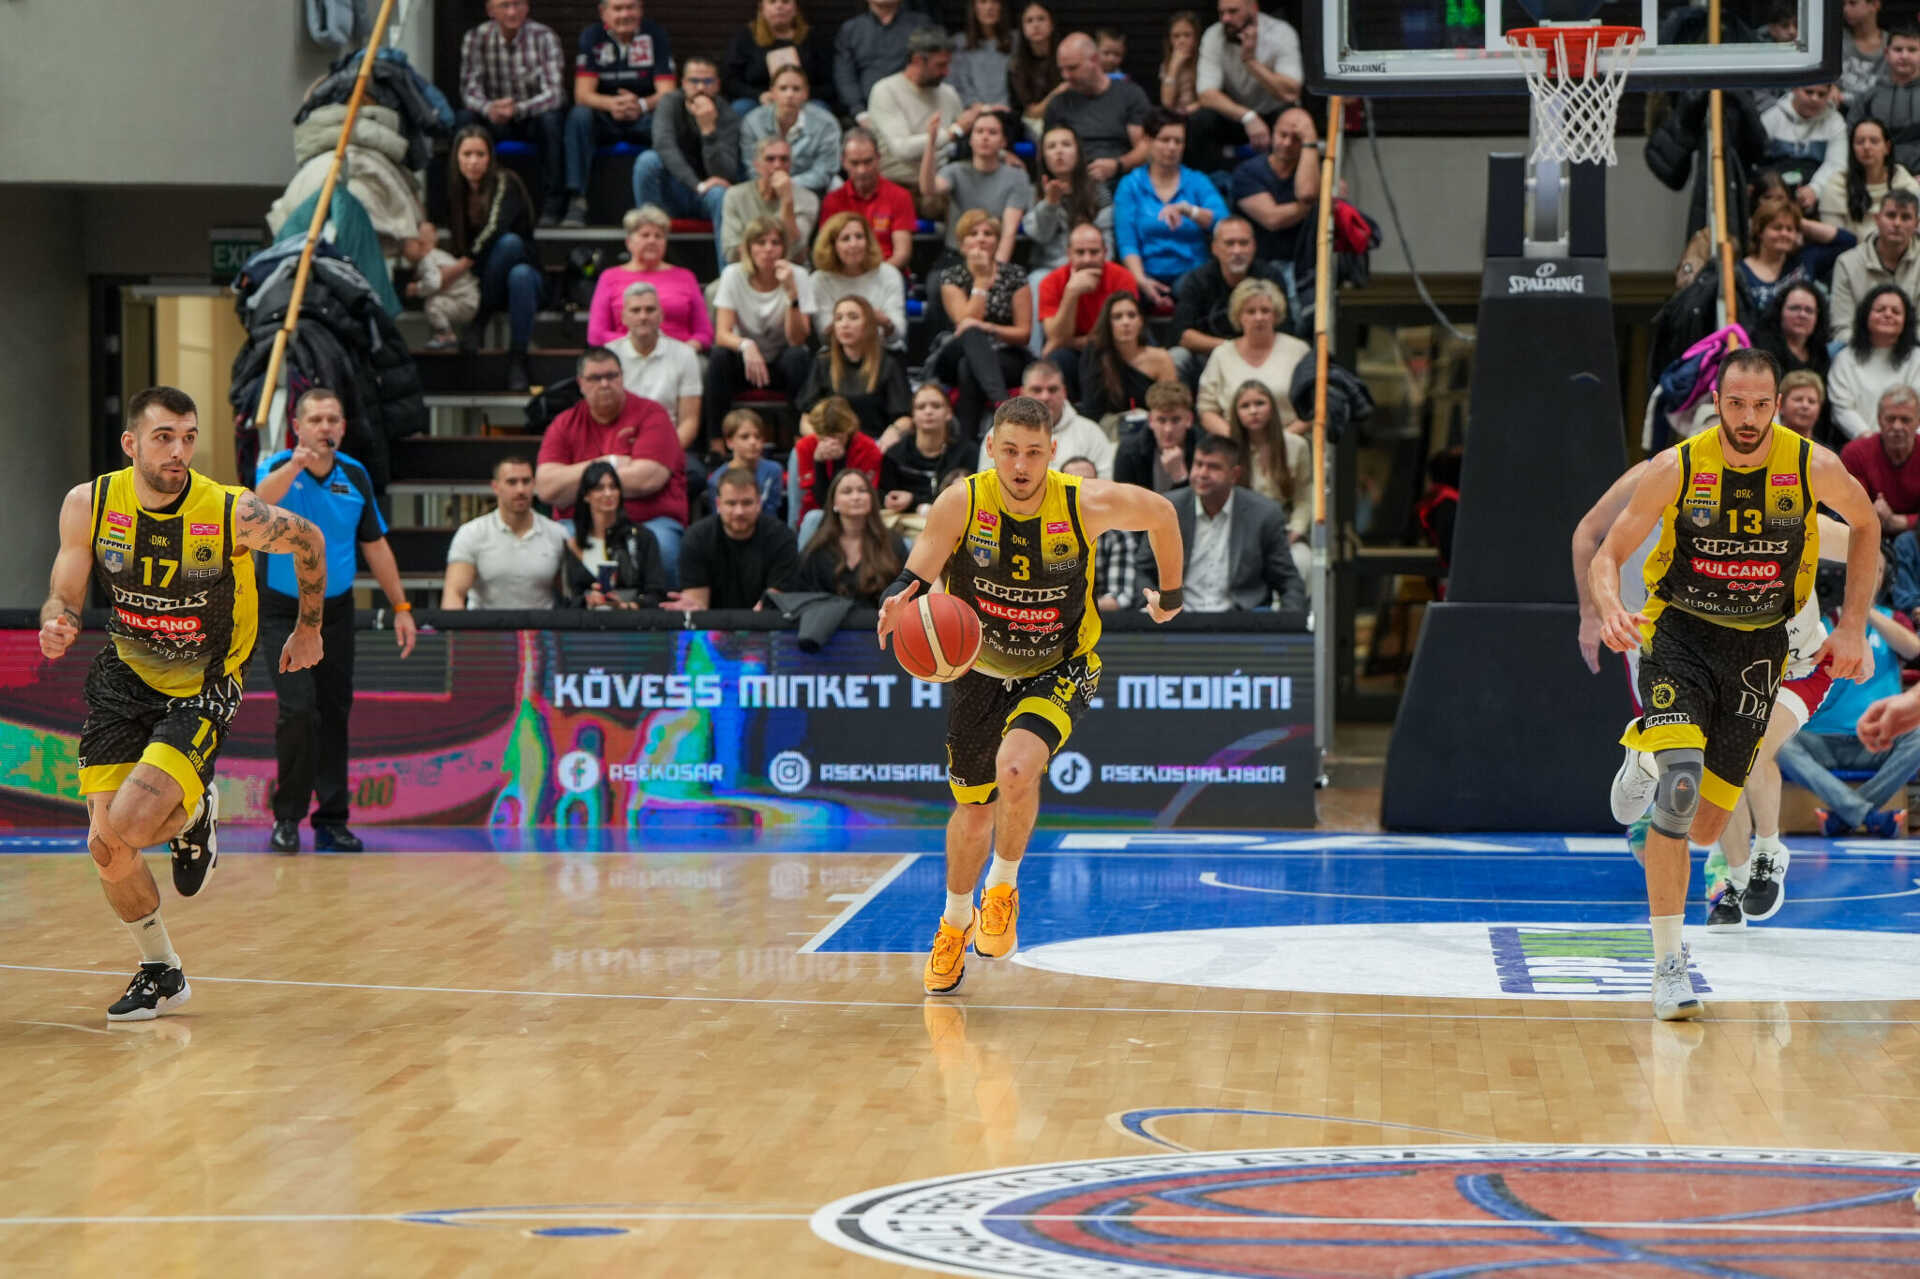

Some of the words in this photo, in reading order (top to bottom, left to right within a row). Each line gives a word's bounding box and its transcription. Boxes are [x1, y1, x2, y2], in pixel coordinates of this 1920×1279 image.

[1337, 62, 1387, 74] SPALDING
[1508, 274, 1584, 294] SPALDING
[1726, 508, 1764, 535] 13
[140, 556, 179, 588] 17
[1011, 554, 1031, 581] 3
[1693, 560, 1778, 578] VULCANO
[979, 601, 1056, 621] VULCANO
[554, 667, 723, 709] KÖVESS
[739, 675, 899, 708] MINKET
[911, 675, 942, 708] A
[1053, 674, 1077, 702] 3
[1646, 712, 1690, 728] IPPMIX
[609, 763, 724, 782] ASEKOSAR
